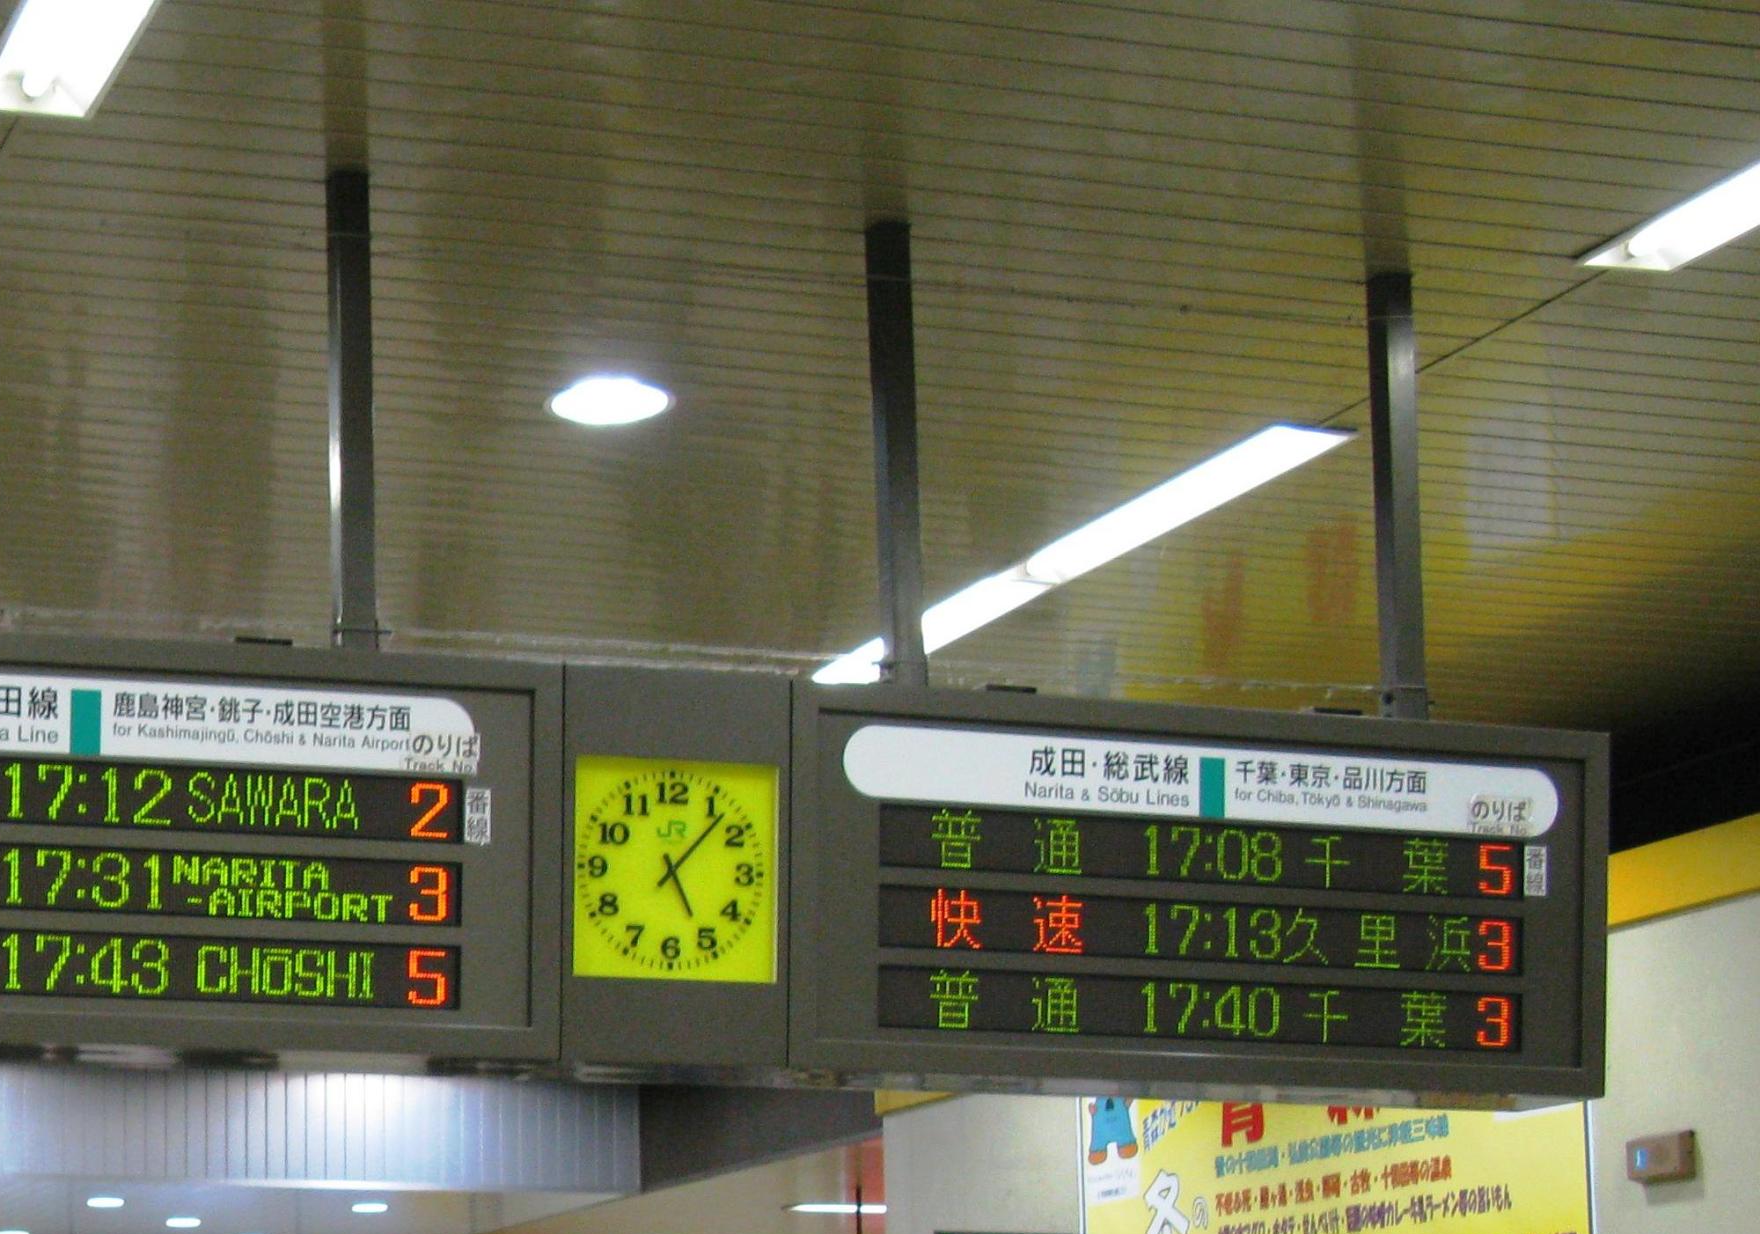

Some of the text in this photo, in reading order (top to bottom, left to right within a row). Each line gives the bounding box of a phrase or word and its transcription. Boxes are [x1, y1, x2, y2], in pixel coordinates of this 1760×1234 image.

[113, 692, 411, 731] 鹿島神宮・銚子・成田空港方面
[17, 724, 59, 744] Line
[113, 722, 132, 737] for
[243, 727, 294, 746] Chōshi
[312, 733, 357, 750] Narita
[361, 736, 409, 754] Airport
[411, 733, 479, 758] のりば
[1029, 744, 1190, 786] 成田・総武線
[1234, 759, 1427, 795] 千葉・東京・品川方面
[5, 763, 172, 825] 17:12
[188, 772, 358, 829] SAWARA
[408, 782, 451, 839] 2
[624, 793, 649, 817] 11
[657, 781, 689, 806] 12
[1024, 781, 1075, 801] Narita
[1080, 787, 1090, 801] &
[1146, 788, 1190, 807] Lines
[1234, 787, 1253, 801] for
[1357, 796, 1428, 814] Shinagawa
[466, 789, 491, 843] 番線
[706, 795, 716, 818] 1
[1471, 799, 1527, 822] のりば
[598, 821, 630, 846] 10
[656, 819, 688, 839] JR
[724, 824, 745, 848] 2
[932, 811, 1513, 895] 普通 17:08 千葉 5
[4, 849, 329, 909] 17:31 NARITA
[587, 855, 608, 878] 9
[734, 863, 755, 887] 3
[409, 865, 451, 922] 3
[598, 893, 619, 916] 8
[719, 899, 741, 922] 4
[625, 924, 645, 948] 7
[696, 927, 718, 951] 5
[931, 889, 1512, 970] 快速 17:13 久里浜 3
[660, 936, 681, 960] 6
[3, 934, 169, 994] 17:43
[407, 949, 448, 1007] 5
[931, 972, 1511, 1046] 普通 17:40 千葉 3
